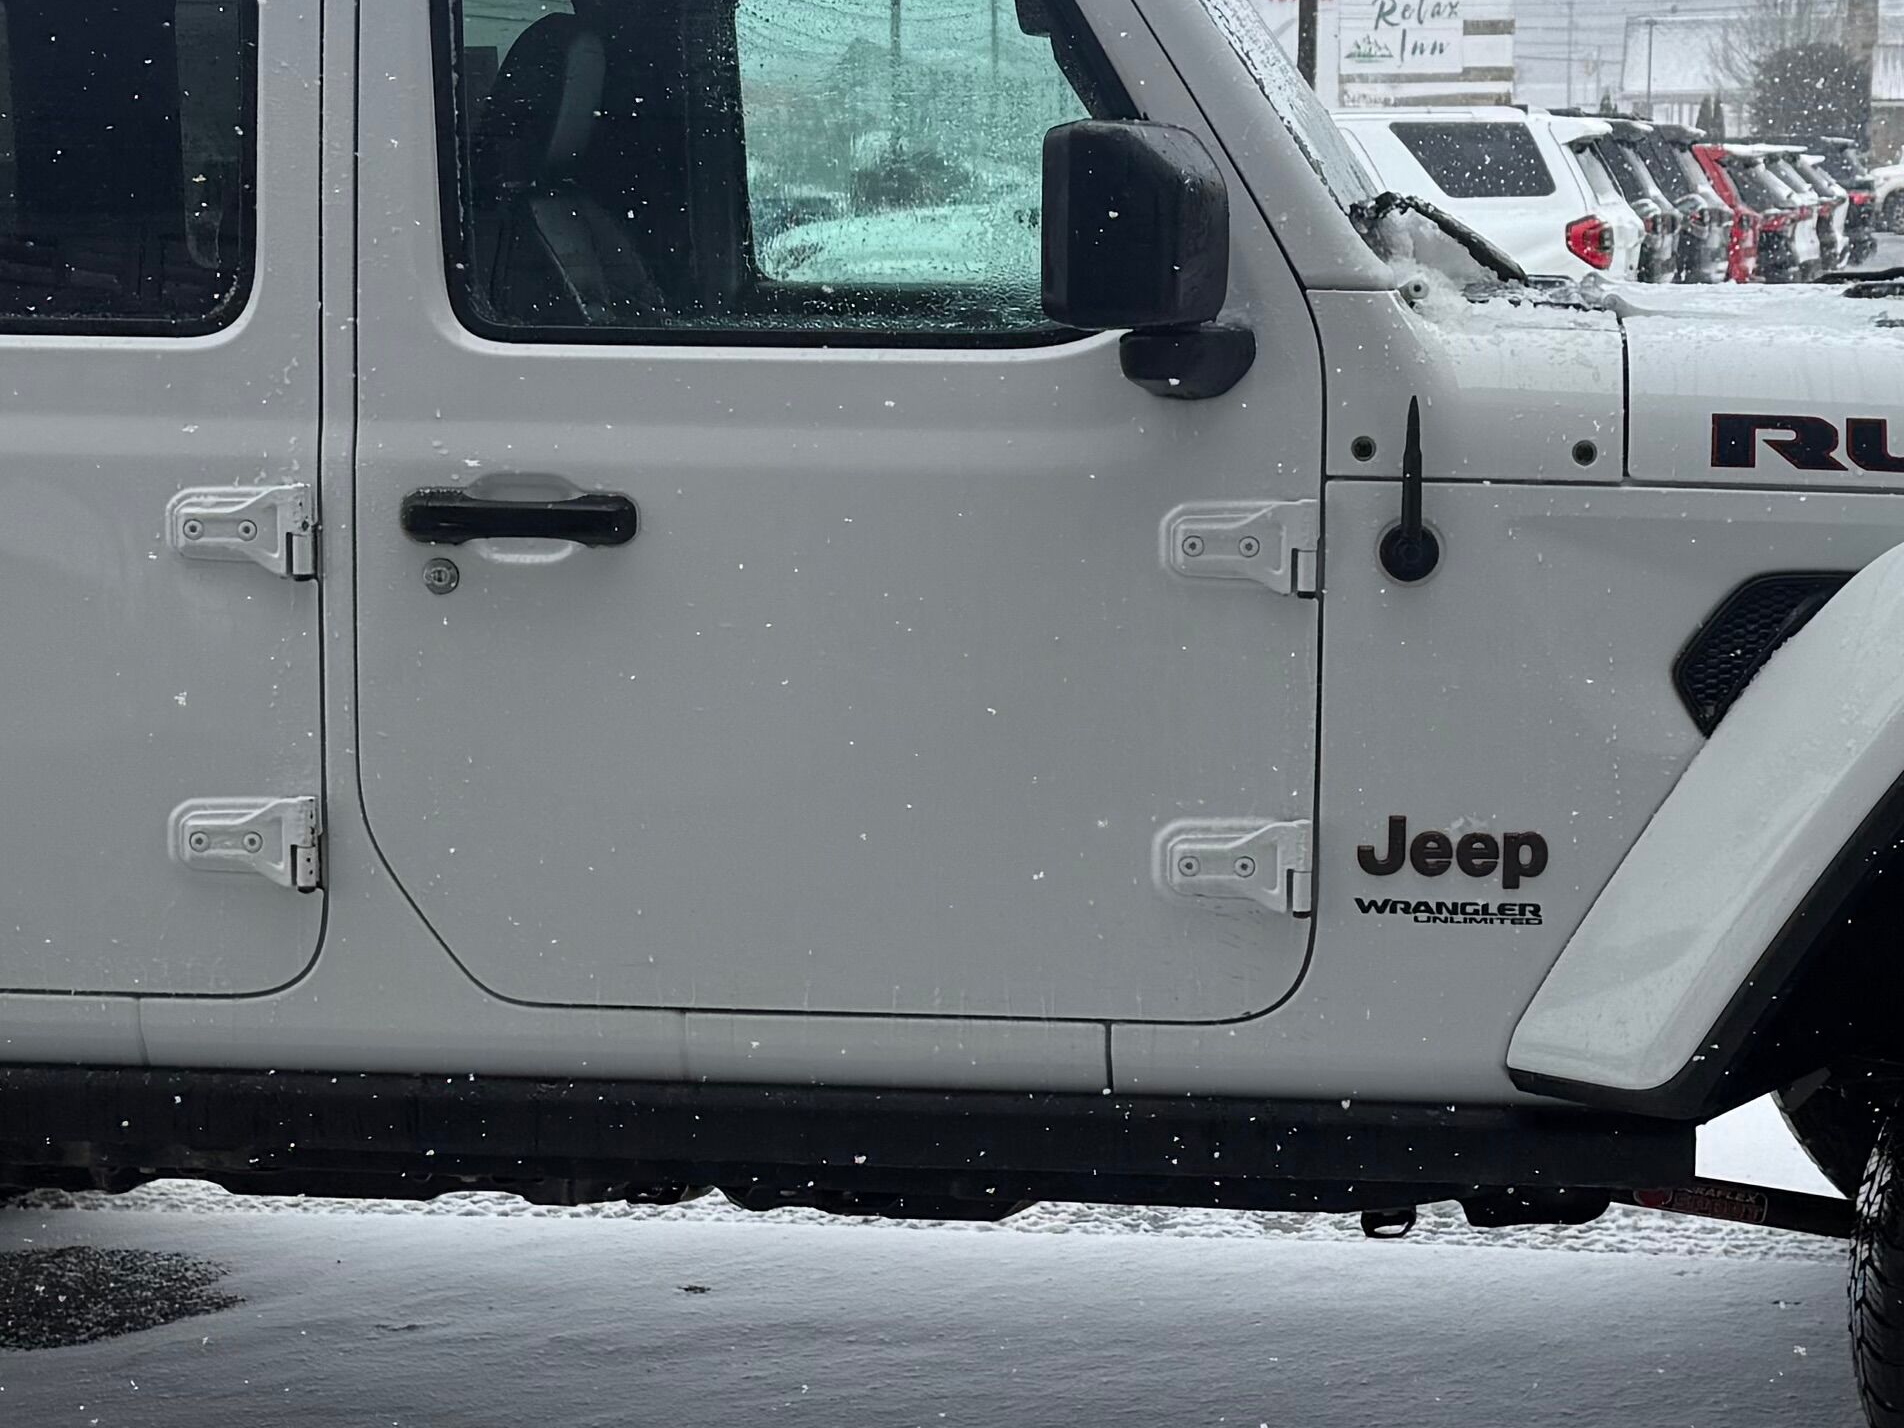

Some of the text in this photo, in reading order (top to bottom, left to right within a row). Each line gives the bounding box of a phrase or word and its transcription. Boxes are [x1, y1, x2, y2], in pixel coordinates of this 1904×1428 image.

[1397, 29, 1452, 68] Inn
[1357, 815, 1549, 890] Jeep
[1354, 897, 1543, 918] WRANGLER
[1413, 915, 1544, 926] UNLIMITED
